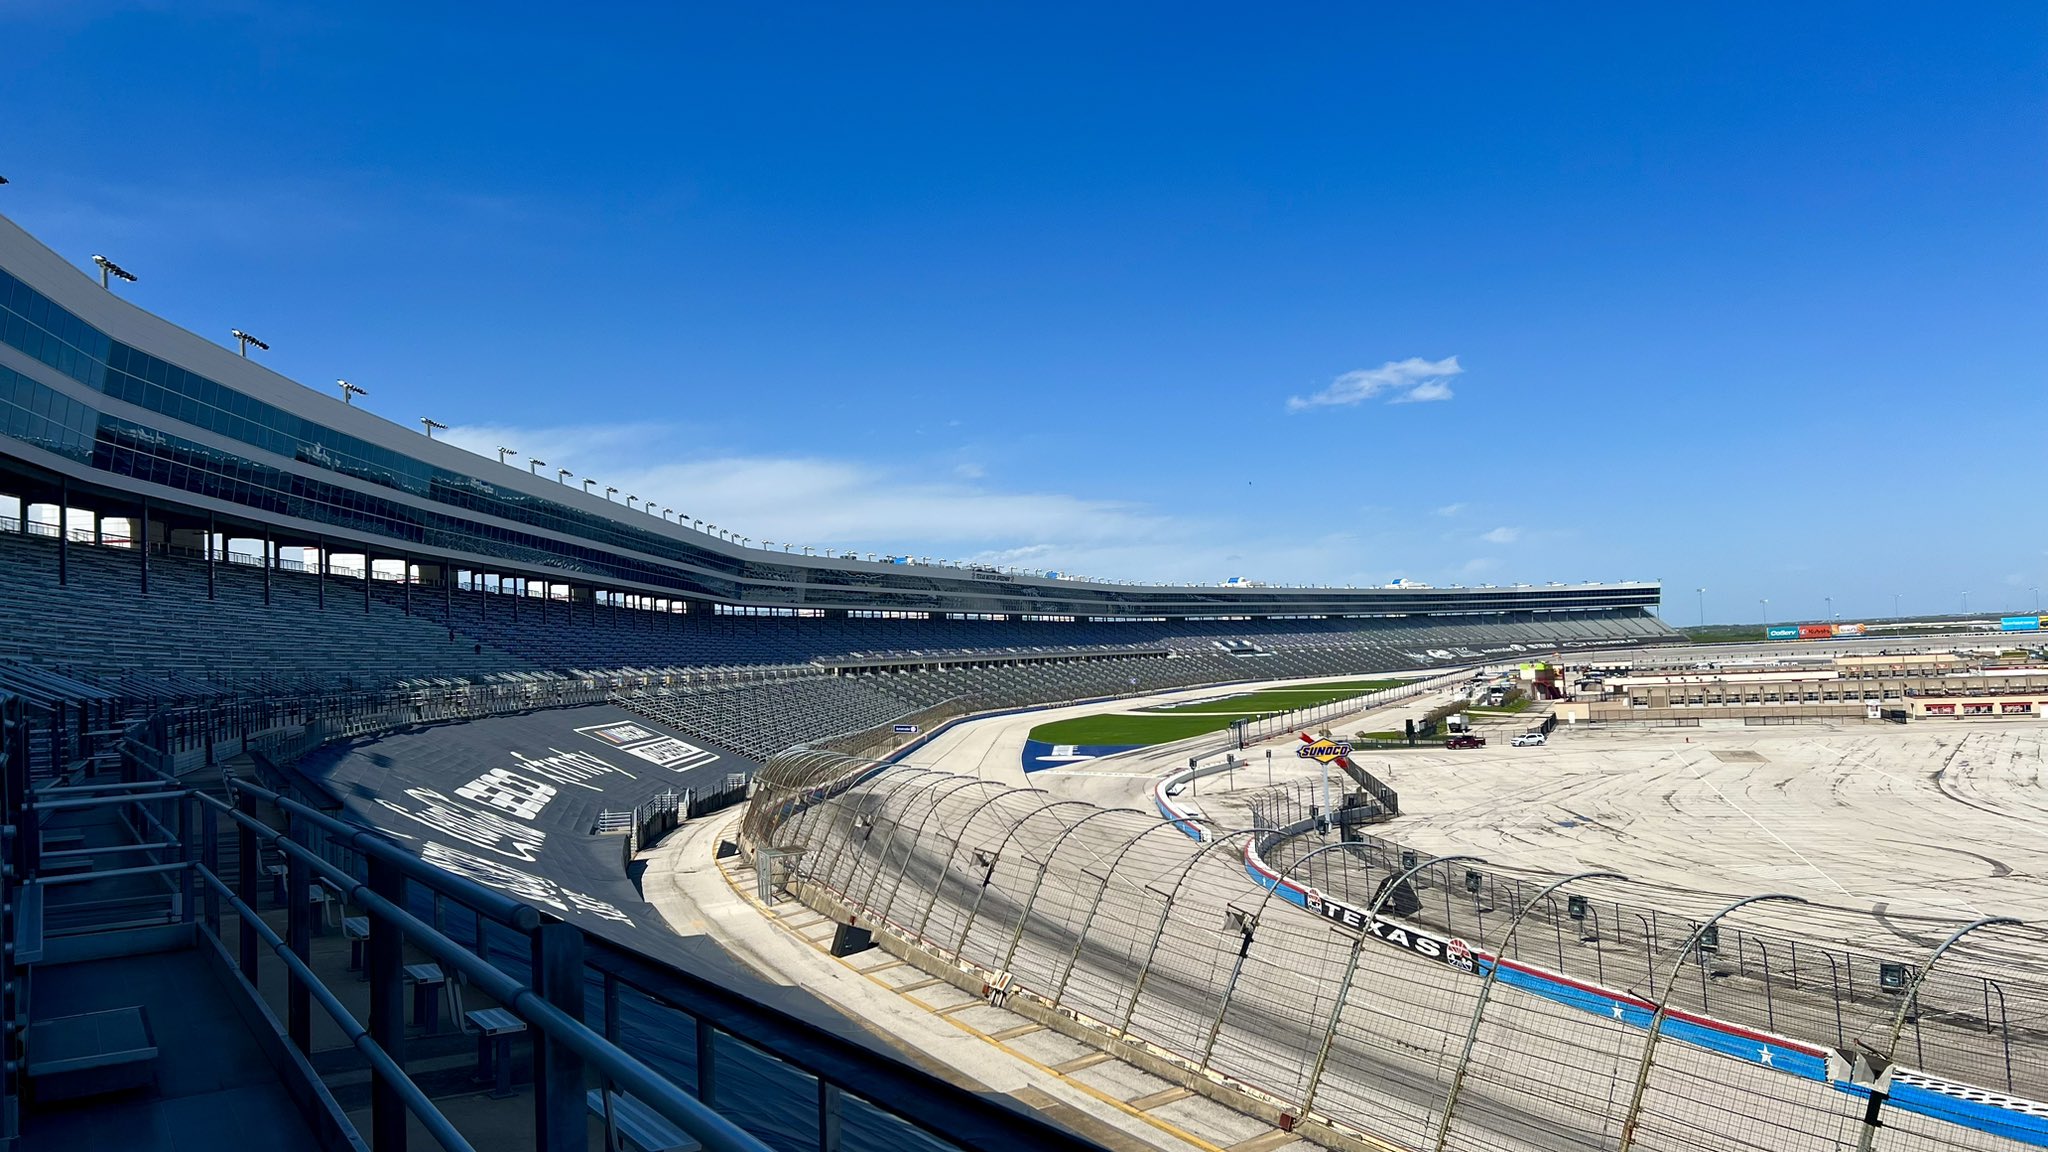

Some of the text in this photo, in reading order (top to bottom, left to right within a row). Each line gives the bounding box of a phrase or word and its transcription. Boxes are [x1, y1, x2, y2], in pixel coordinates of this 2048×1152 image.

[1770, 629, 1797, 637] CoServ
[1301, 746, 1348, 757] SUNOCO
[453, 767, 558, 821] GEICO
[1323, 901, 1441, 957] TEXAS
